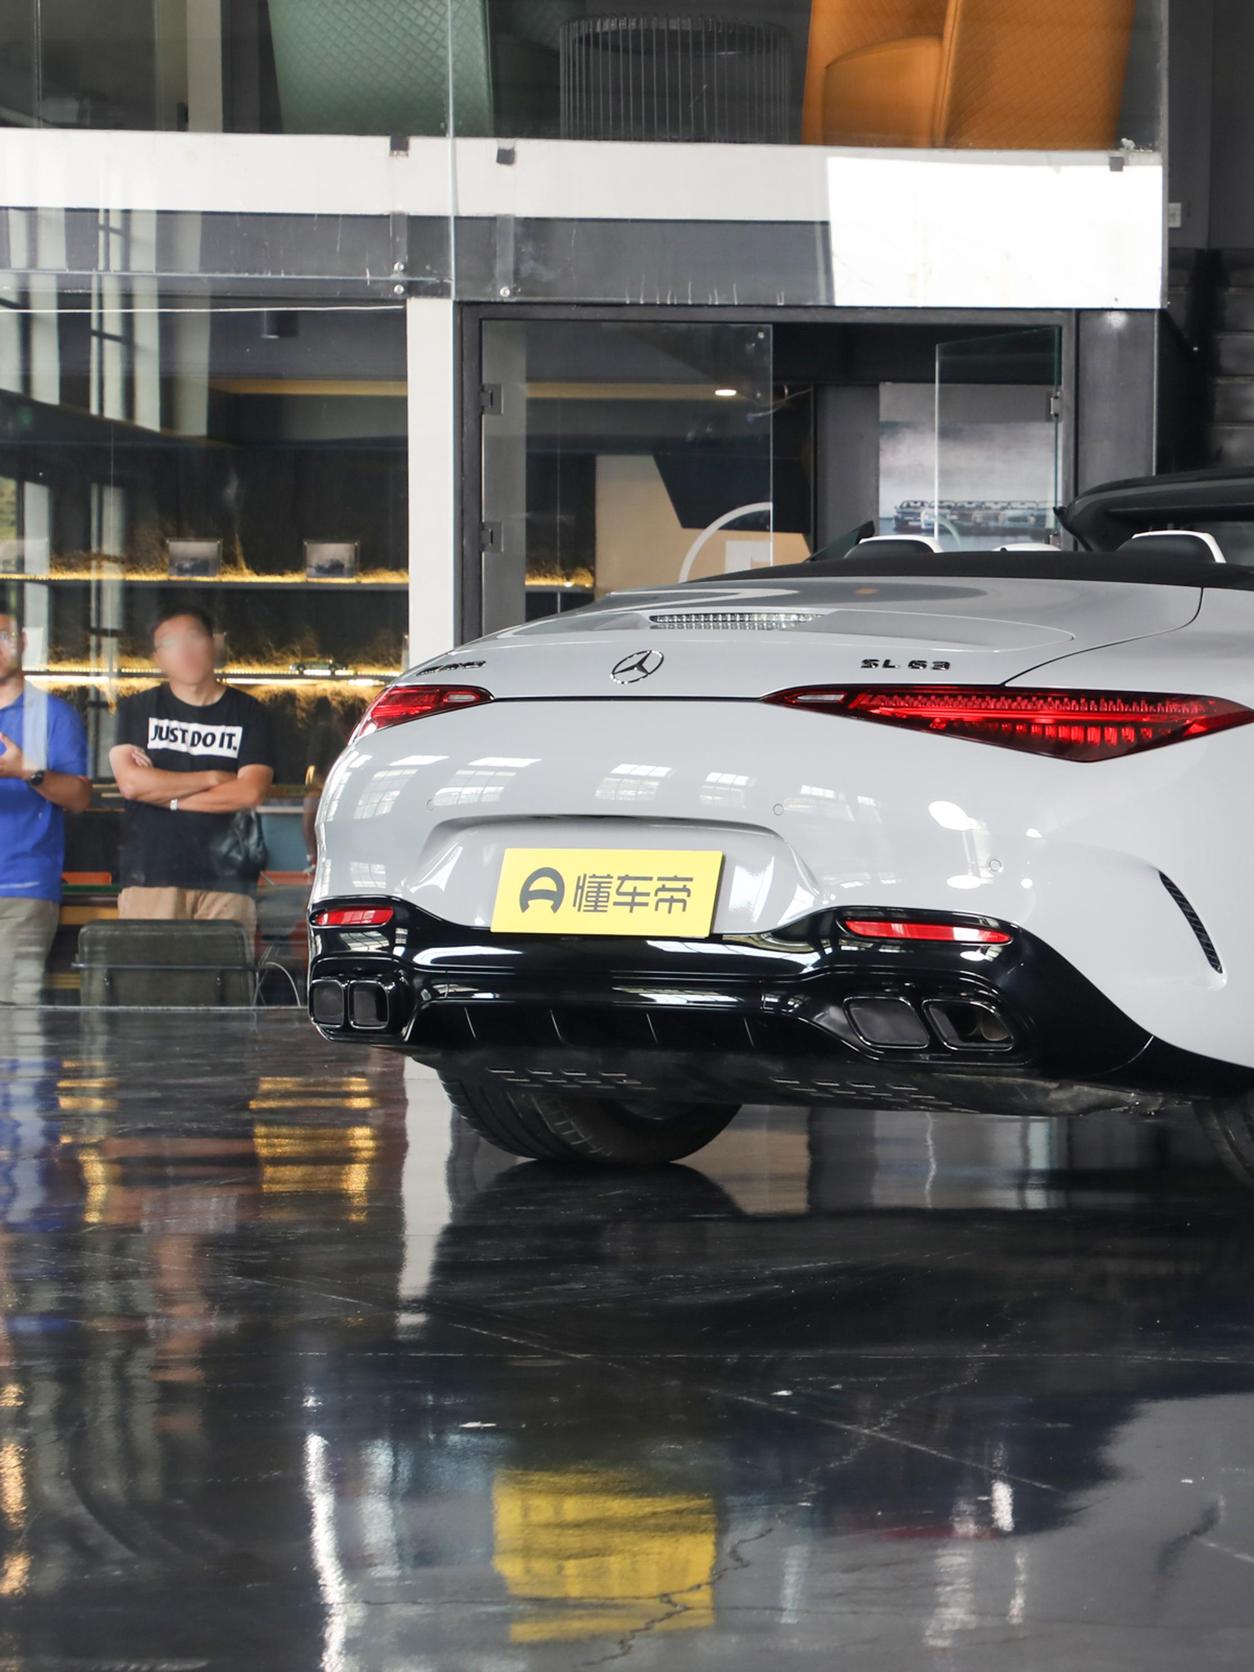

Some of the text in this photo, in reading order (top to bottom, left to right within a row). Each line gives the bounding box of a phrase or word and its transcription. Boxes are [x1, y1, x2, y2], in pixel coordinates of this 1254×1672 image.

[860, 659, 951, 671] SL 63
[151, 725, 237, 751] JUST DO IT.
[572, 873, 694, 914] 懂车帝
